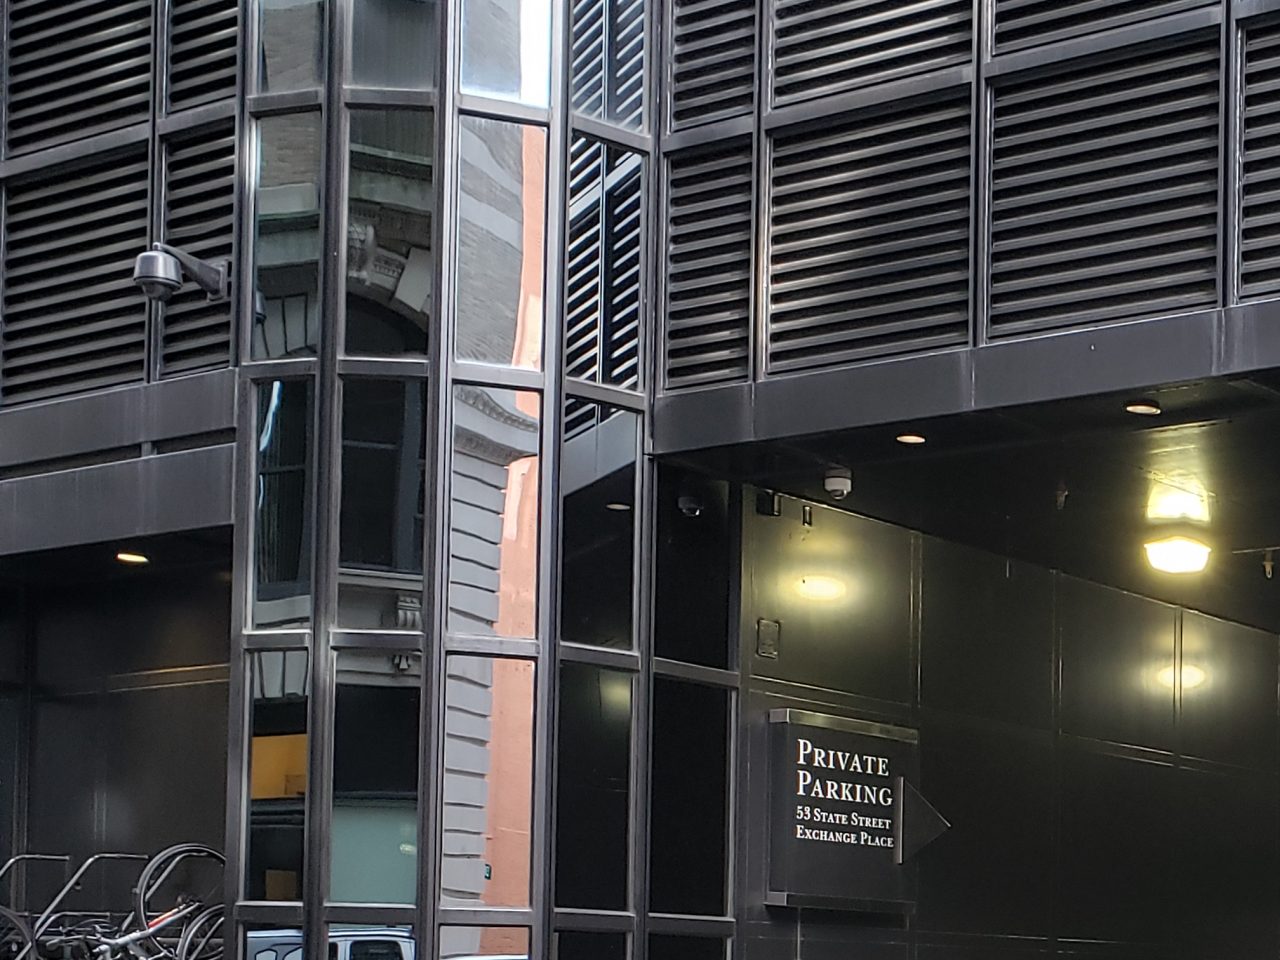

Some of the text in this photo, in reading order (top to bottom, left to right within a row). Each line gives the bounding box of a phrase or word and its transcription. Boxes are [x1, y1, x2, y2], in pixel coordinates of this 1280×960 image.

[797, 739, 889, 776] PRIVATE
[797, 770, 893, 806] PARKING
[796, 805, 892, 829] 53 STATE STREET
[796, 825, 894, 848] EXCHANGE PLACE
